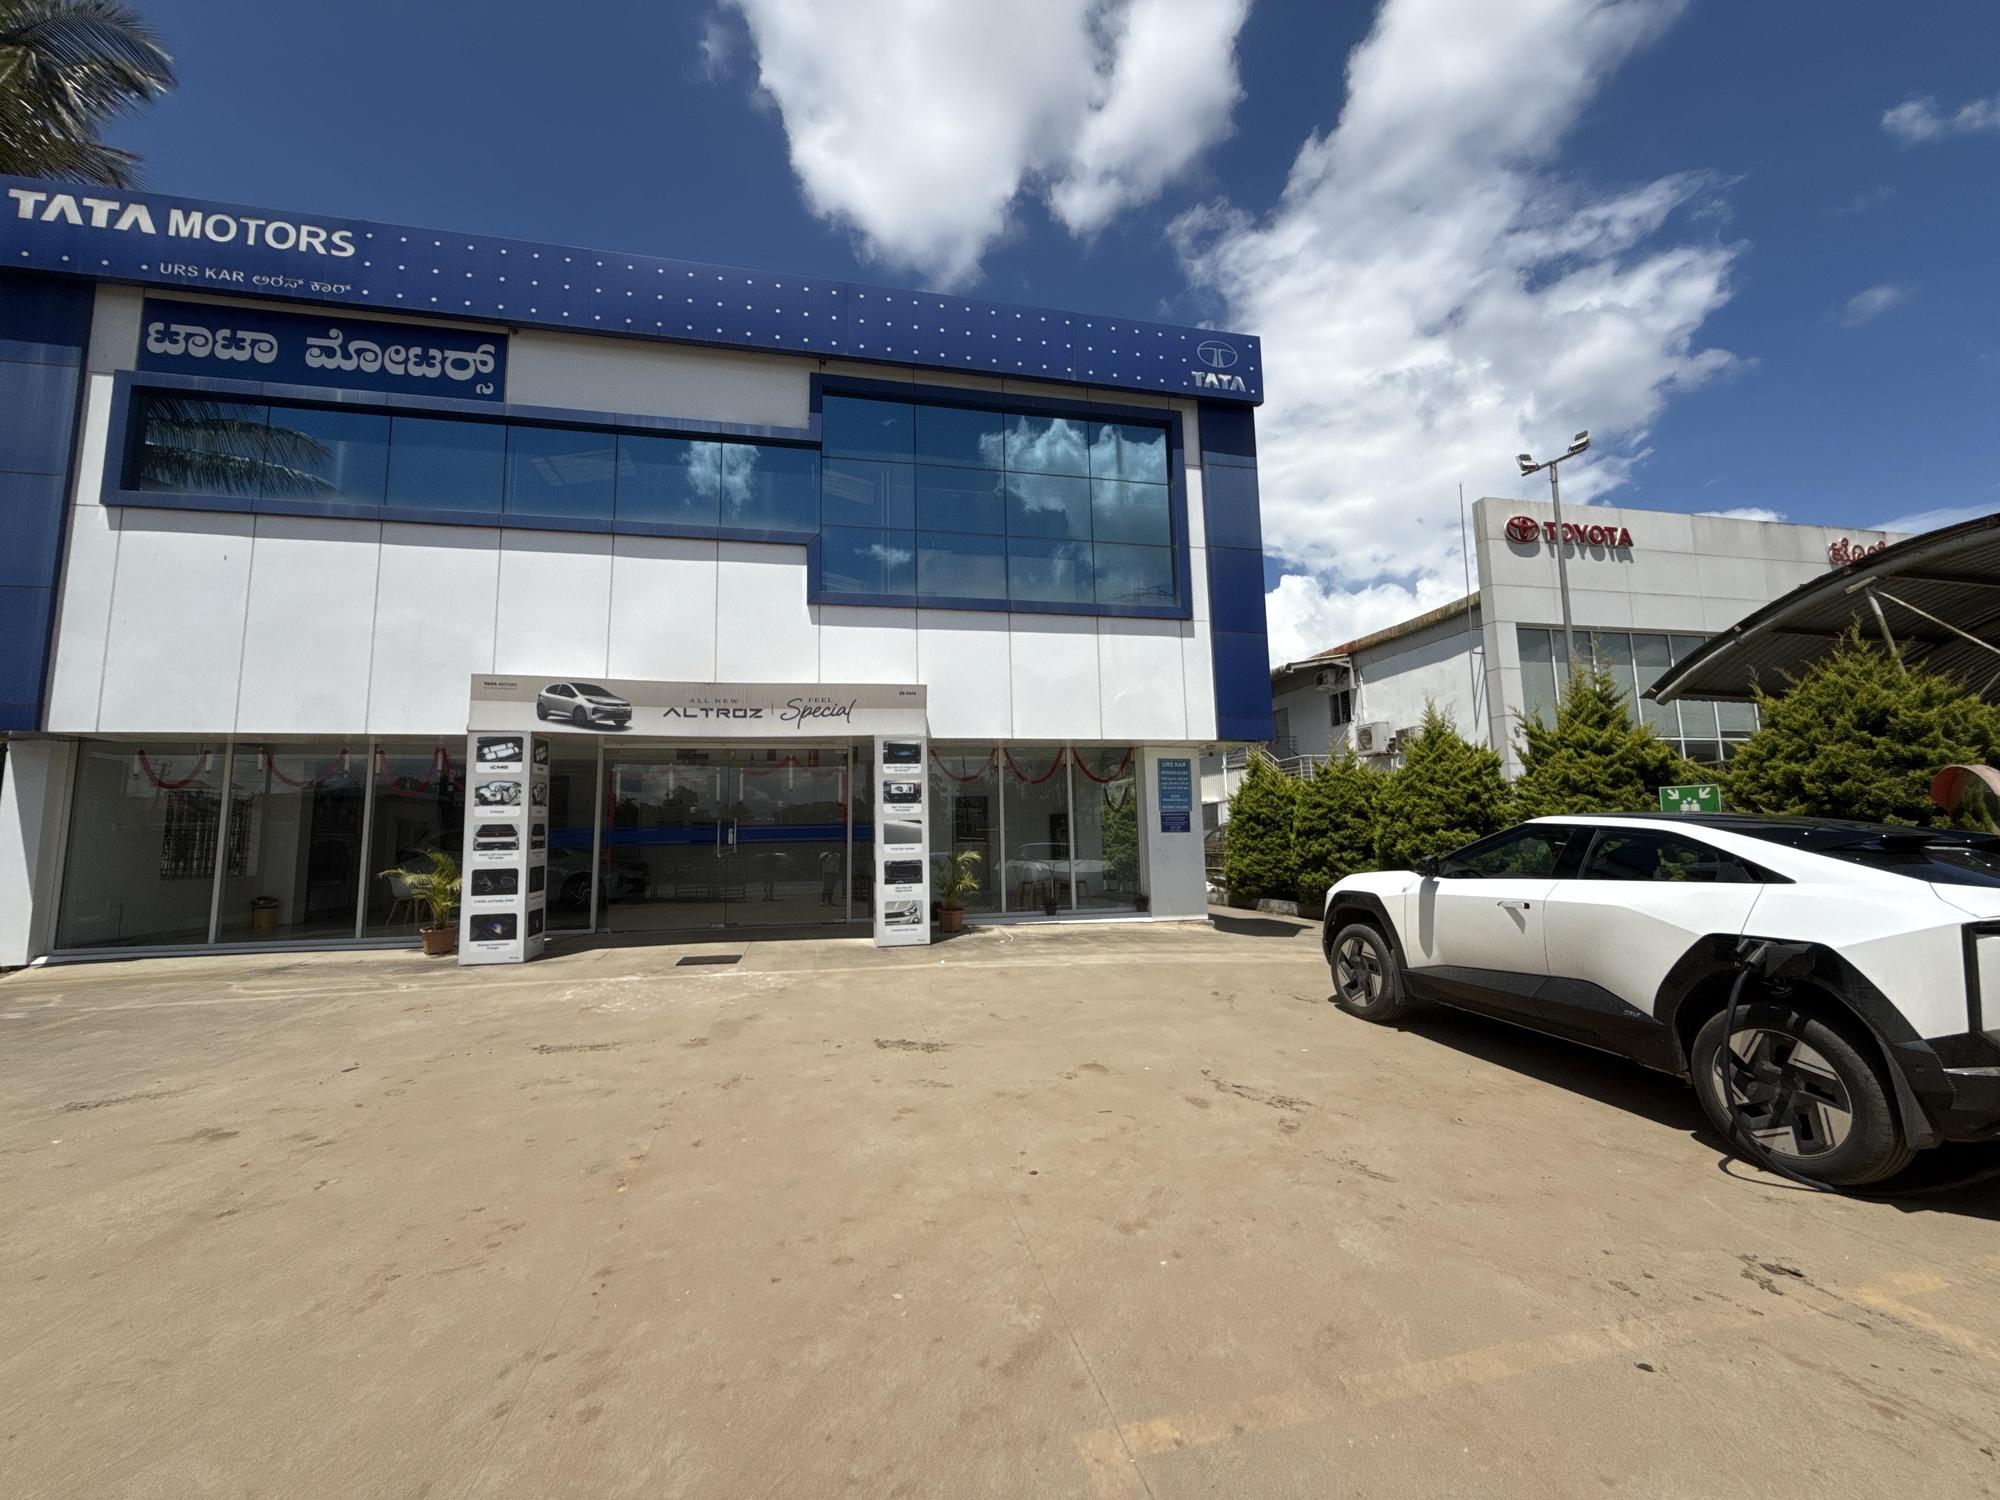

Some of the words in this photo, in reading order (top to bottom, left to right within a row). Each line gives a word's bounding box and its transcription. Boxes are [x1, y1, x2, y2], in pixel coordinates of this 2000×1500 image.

[8, 188, 157, 235] TATA
[168, 208, 356, 257] MOTORS
[160, 262, 199, 278] URS
[205, 267, 245, 283] KAR
[146, 321, 278, 364] ಟಾಟಾ
[1191, 370, 1247, 393] TATA
[1543, 521, 1634, 547] TOYOTA
[662, 707, 763, 719] ALTROZ
[780, 697, 857, 730] Special
